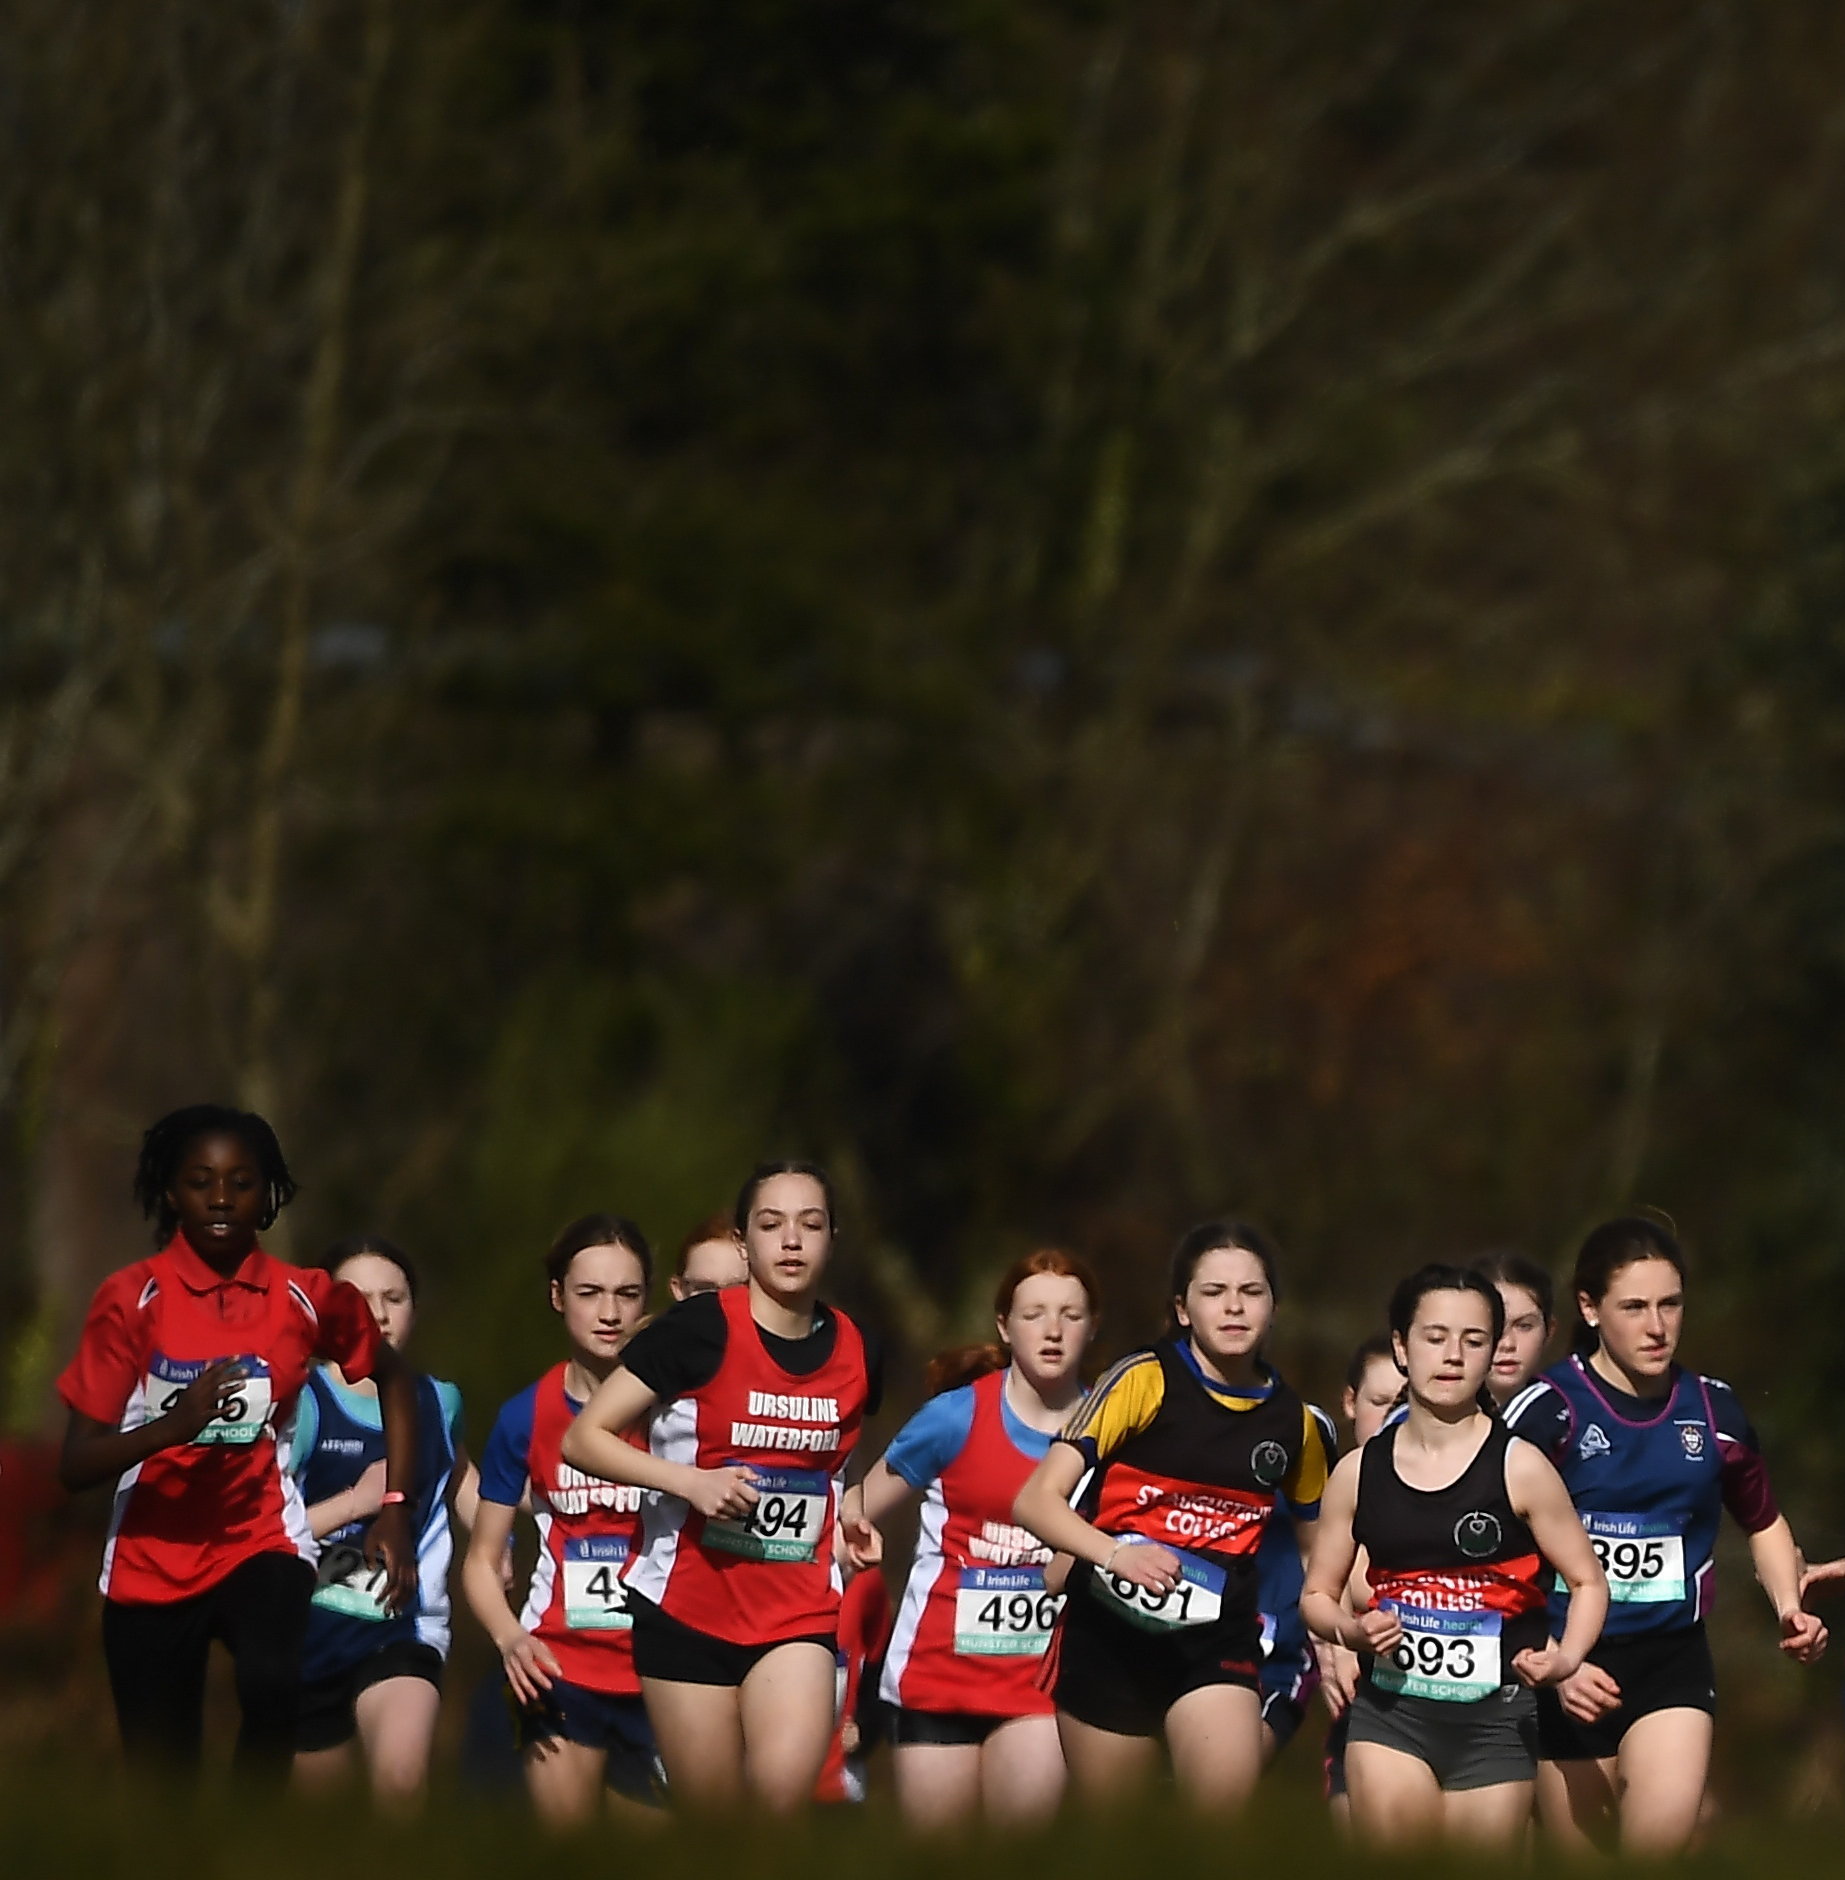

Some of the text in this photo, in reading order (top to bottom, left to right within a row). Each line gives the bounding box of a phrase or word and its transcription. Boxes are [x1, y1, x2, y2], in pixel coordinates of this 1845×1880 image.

[748, 1390, 840, 1423] URSULINE
[205, 1426, 256, 1439] SCHOOL
[731, 1421, 841, 1452] WATERFORD
[772, 1477, 788, 1489] Life
[1135, 1485, 1164, 1506] ST
[1593, 1519, 1618, 1534] Irish
[1618, 1520, 1637, 1535] Life
[987, 1575, 1011, 1587] Irish
[1012, 1573, 1031, 1587] Life
[978, 1593, 1058, 1633] 496
[1420, 1614, 1441, 1630] Life
[1442, 1618, 1483, 1631] health
[1392, 1630, 1475, 1679] 693
